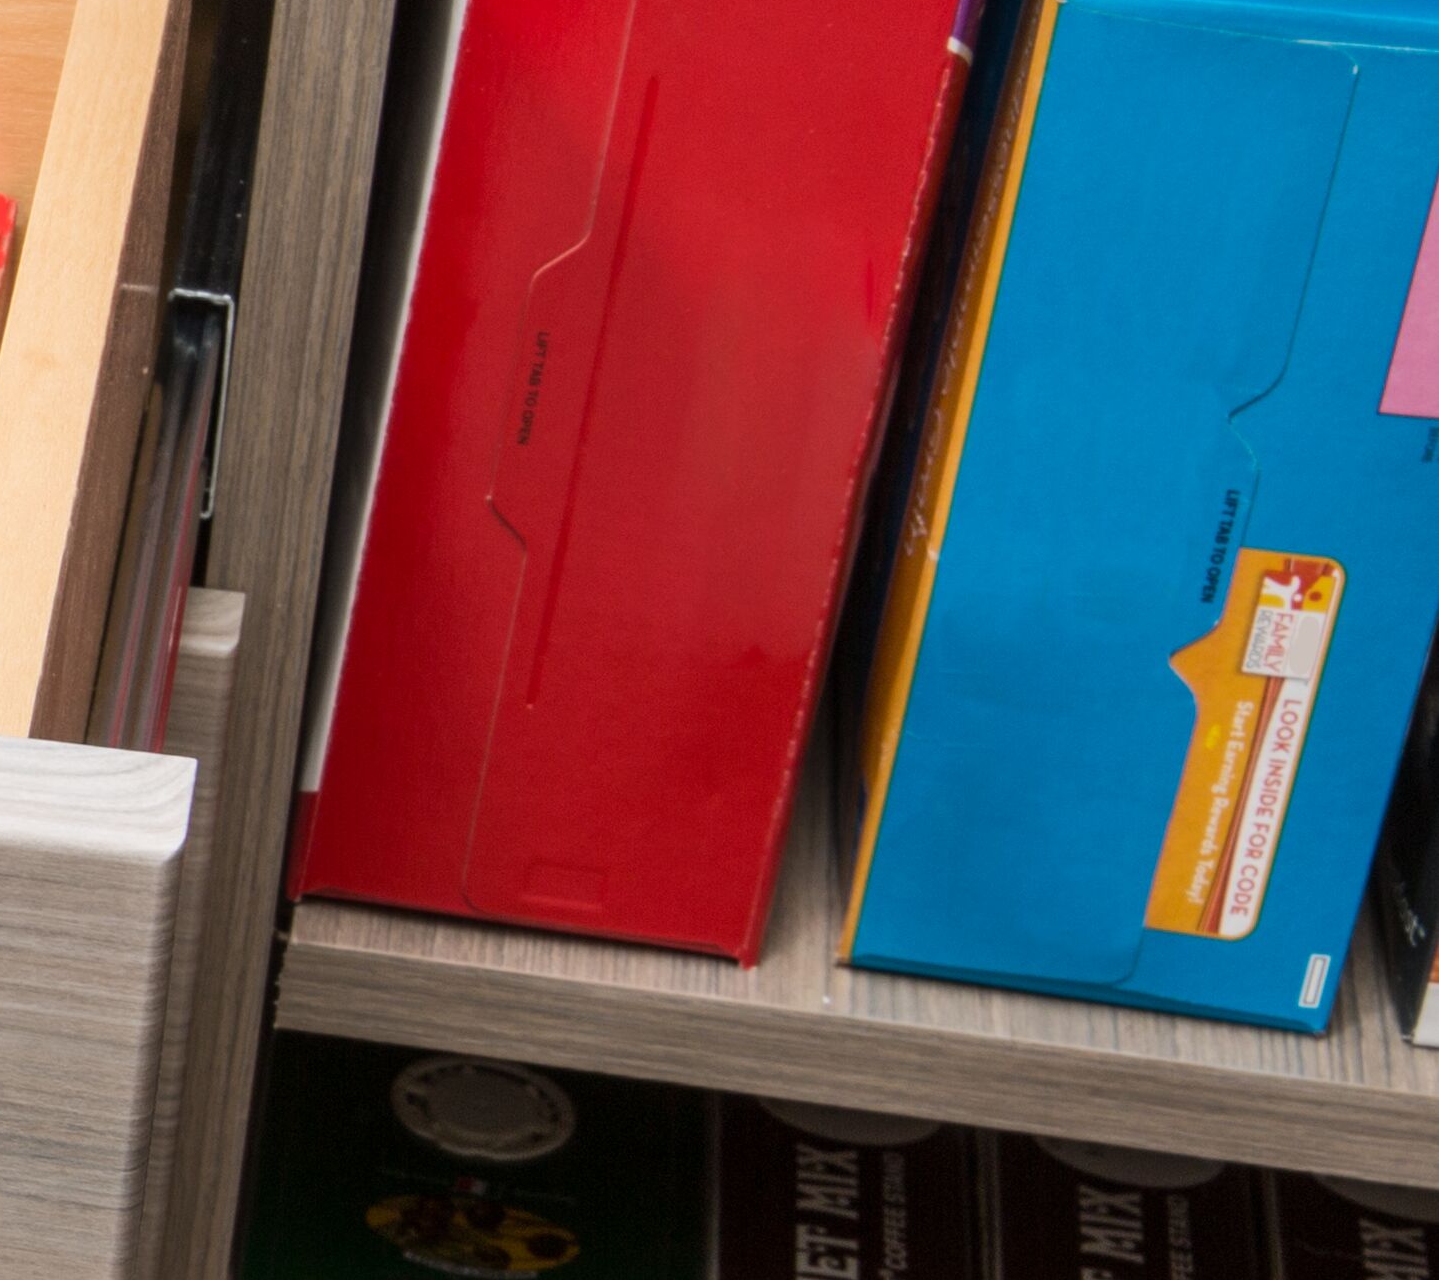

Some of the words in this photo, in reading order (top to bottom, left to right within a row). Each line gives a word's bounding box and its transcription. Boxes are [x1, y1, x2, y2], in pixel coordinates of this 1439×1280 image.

[1224, 489, 1240, 517] LIFT
[1211, 546, 1226, 564] TO
[1217, 519, 1233, 543] TAB
[1201, 566, 1222, 602] OPEN
[1266, 612, 1294, 672] FAMILY
[1273, 699, 1302, 752] LOOK
[1256, 759, 1290, 818] INSIDE
[1244, 822, 1270, 859] FOR
[1230, 865, 1261, 916] CODE
[796, 1143, 860, 1220] MIX
[1079, 1184, 1146, 1265] MIX
